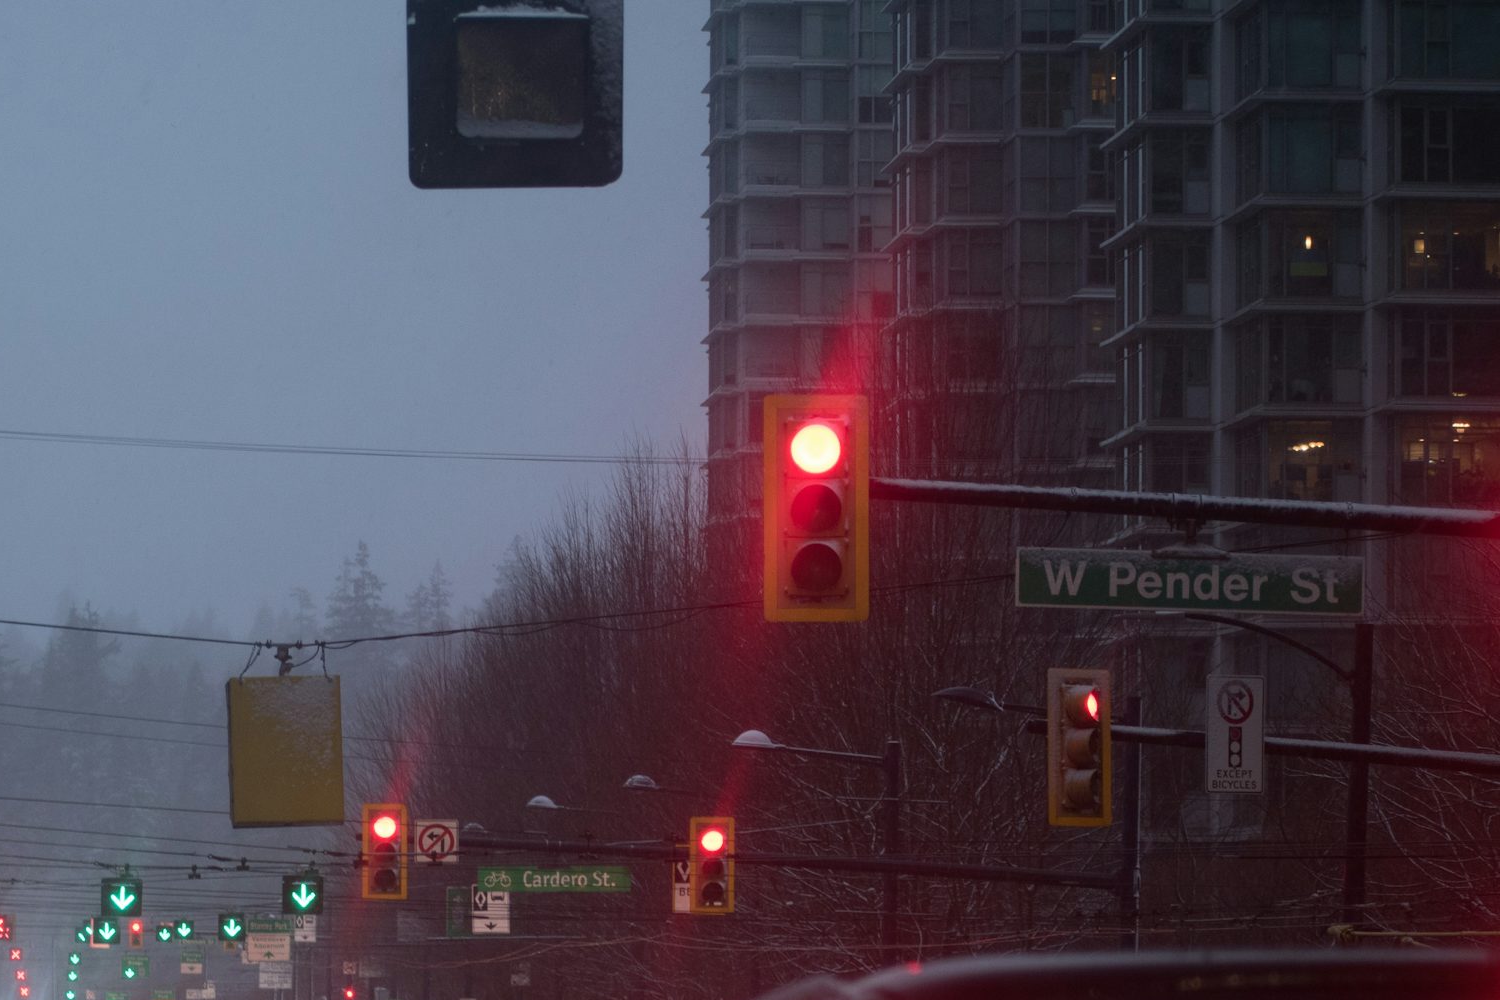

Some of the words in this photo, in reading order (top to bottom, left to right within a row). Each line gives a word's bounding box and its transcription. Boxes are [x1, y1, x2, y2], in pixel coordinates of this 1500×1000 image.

[1043, 559, 1087, 597] W
[1108, 561, 1269, 603] Pender
[1289, 567, 1340, 605] St
[1216, 769, 1253, 779] EXCEPT
[1212, 779, 1257, 790] BICYCLES
[522, 870, 588, 888] Cardero
[592, 871, 617, 888] St.
